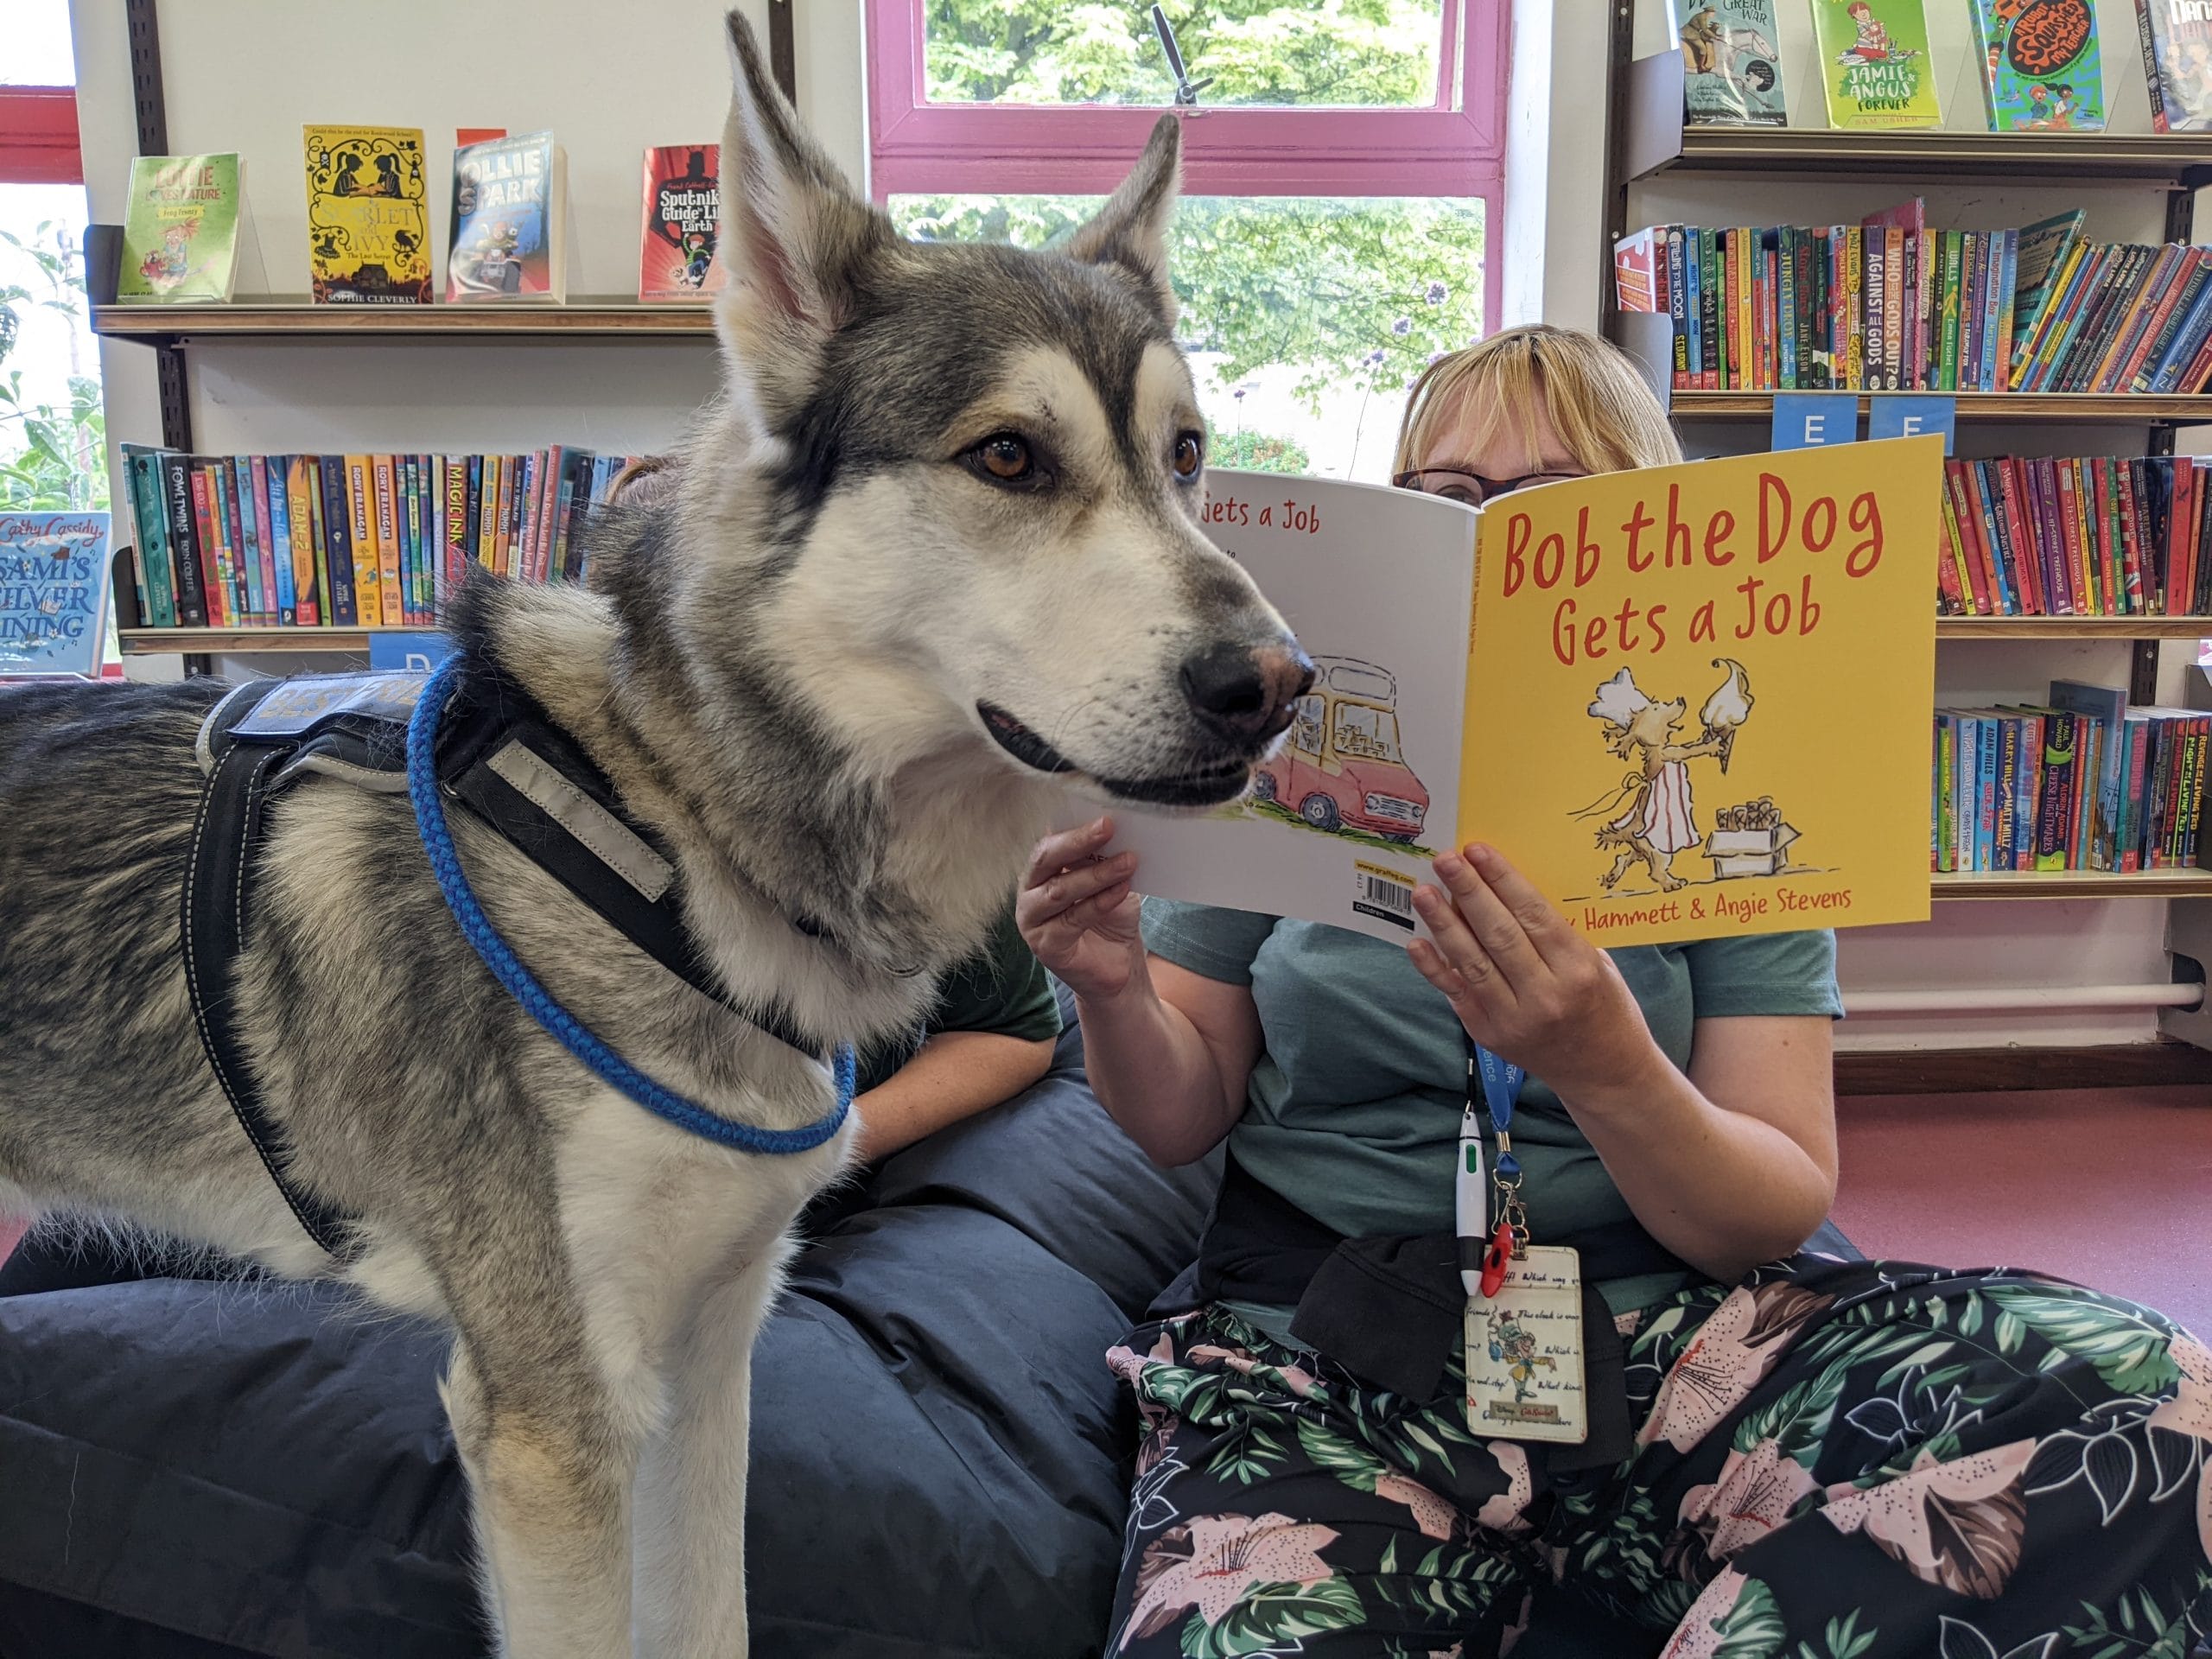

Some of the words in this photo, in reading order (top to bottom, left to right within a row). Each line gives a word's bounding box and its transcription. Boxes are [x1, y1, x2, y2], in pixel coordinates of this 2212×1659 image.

[1723, 0, 1764, 10] GREAT
[1742, 10, 1768, 26] WAR
[2018, 3, 2049, 33] ROBOT
[2022, 3, 2079, 60] SQUASHED
[2050, 49, 2072, 65] MY
[2066, 19, 2089, 48] TEACHER
[1849, 65, 1904, 85] JAMIE
[1908, 73, 1915, 82] &
[1850, 81, 1911, 99] ANGUS
[1858, 99, 1910, 111] FOREVER
[461, 149, 543, 188] OLLIE
[458, 177, 543, 215] SPARK
[662, 207, 699, 220] Guide
[682, 220, 713, 232] Earth
[353, 235, 389, 251] IVY
[1670, 242, 1683, 270] TALKING
[1887, 247, 1901, 282] WHO
[1948, 251, 1958, 282] WALLS
[1990, 252, 2001, 299] Imagination
[2103, 268, 2117, 288] LUNA
[2115, 268, 2127, 288] LUNA
[1868, 254, 1883, 314] AGAINST
[2126, 270, 2138, 289] LUNA
[327, 294, 365, 302] SOPHIE
[366, 295, 417, 303] CLEVERLY
[1673, 289, 1684, 319] MOON
[1988, 301, 1999, 316] Box
[1800, 322, 1809, 343] JANE
[1869, 316, 1882, 326] ALL
[1886, 300, 1900, 338] GODS
[1868, 328, 1882, 365] GODS
[1963, 328, 1972, 354] FARAWAY
[1986, 324, 1996, 346] Martyn
[2155, 328, 2173, 351] LIGHT
[1800, 346, 1810, 372] ELSON
[1886, 340, 1900, 374] OUT?
[1986, 348, 1994, 362] Ford
[1804, 415, 1825, 442] E
[171, 466, 186, 499] FOWL
[352, 466, 362, 490] RORY
[377, 466, 388, 490] RORY
[449, 467, 463, 514] MAGIC
[2002, 467, 2012, 498] MARLEY
[174, 499, 188, 532] TWINS
[290, 494, 309, 553] ADAM-2
[354, 491, 366, 540] BRANAGAN
[379, 491, 391, 539] BRANAGAN
[1260, 506, 1271, 526] a
[1282, 499, 1319, 534] Job
[1994, 505, 2005, 520] GIRL
[2067, 505, 2076, 543] 13-STOREY
[2141, 501, 2150, 539] HARLEY
[0, 518, 41, 543] Cathy
[44, 517, 105, 547] Cassidy
[449, 518, 463, 543] INK
[1503, 505, 1600, 597] Bob
[1621, 483, 1736, 574] the
[1758, 473, 1884, 578] Dog
[1999, 534, 2009, 560] JUSTICE
[2047, 518, 2058, 553] 117-STOREY
[2053, 556, 2063, 594] TREEHOUSE
[183, 561, 194, 592] COLFER
[2071, 545, 2082, 585] TREEHOUSE
[0, 586, 95, 614] ILVER
[0, 613, 84, 638] INING
[1553, 598, 1667, 666] Gets
[1688, 601, 1717, 643] a
[1734, 575, 1821, 639] Job
[1986, 727, 1995, 750] ADAM
[2005, 732, 2016, 764] HARRY
[2196, 735, 2208, 770] REVENGE
[1984, 753, 1994, 775] HILLS
[2173, 737, 2183, 771] INVASION
[2185, 737, 2196, 770] NIGHT
[2004, 765, 2015, 783] HILL
[2047, 766, 2059, 796] CHEESE
[2058, 783, 2069, 811] ALDRIN
[2171, 780, 2180, 812] LIVING
[2181, 780, 2191, 813] LIVING
[2192, 778, 2203, 811] LIVING
[2004, 799, 2013, 823] MATT
[2166, 815, 2175, 832] TED
[2178, 815, 2187, 832] TED
[2190, 813, 2199, 830] TED
[2002, 824, 2012, 849] MILLZ
[2043, 798, 2057, 853] NIGHTMARES
[2057, 813, 2067, 839] ADAMS
[1356, 904, 1384, 917] Children
[1585, 904, 1681, 931] Hammett
[1690, 903, 1706, 919] &
[1715, 893, 1768, 923] Angie
[1777, 887, 1852, 913] Stevens
